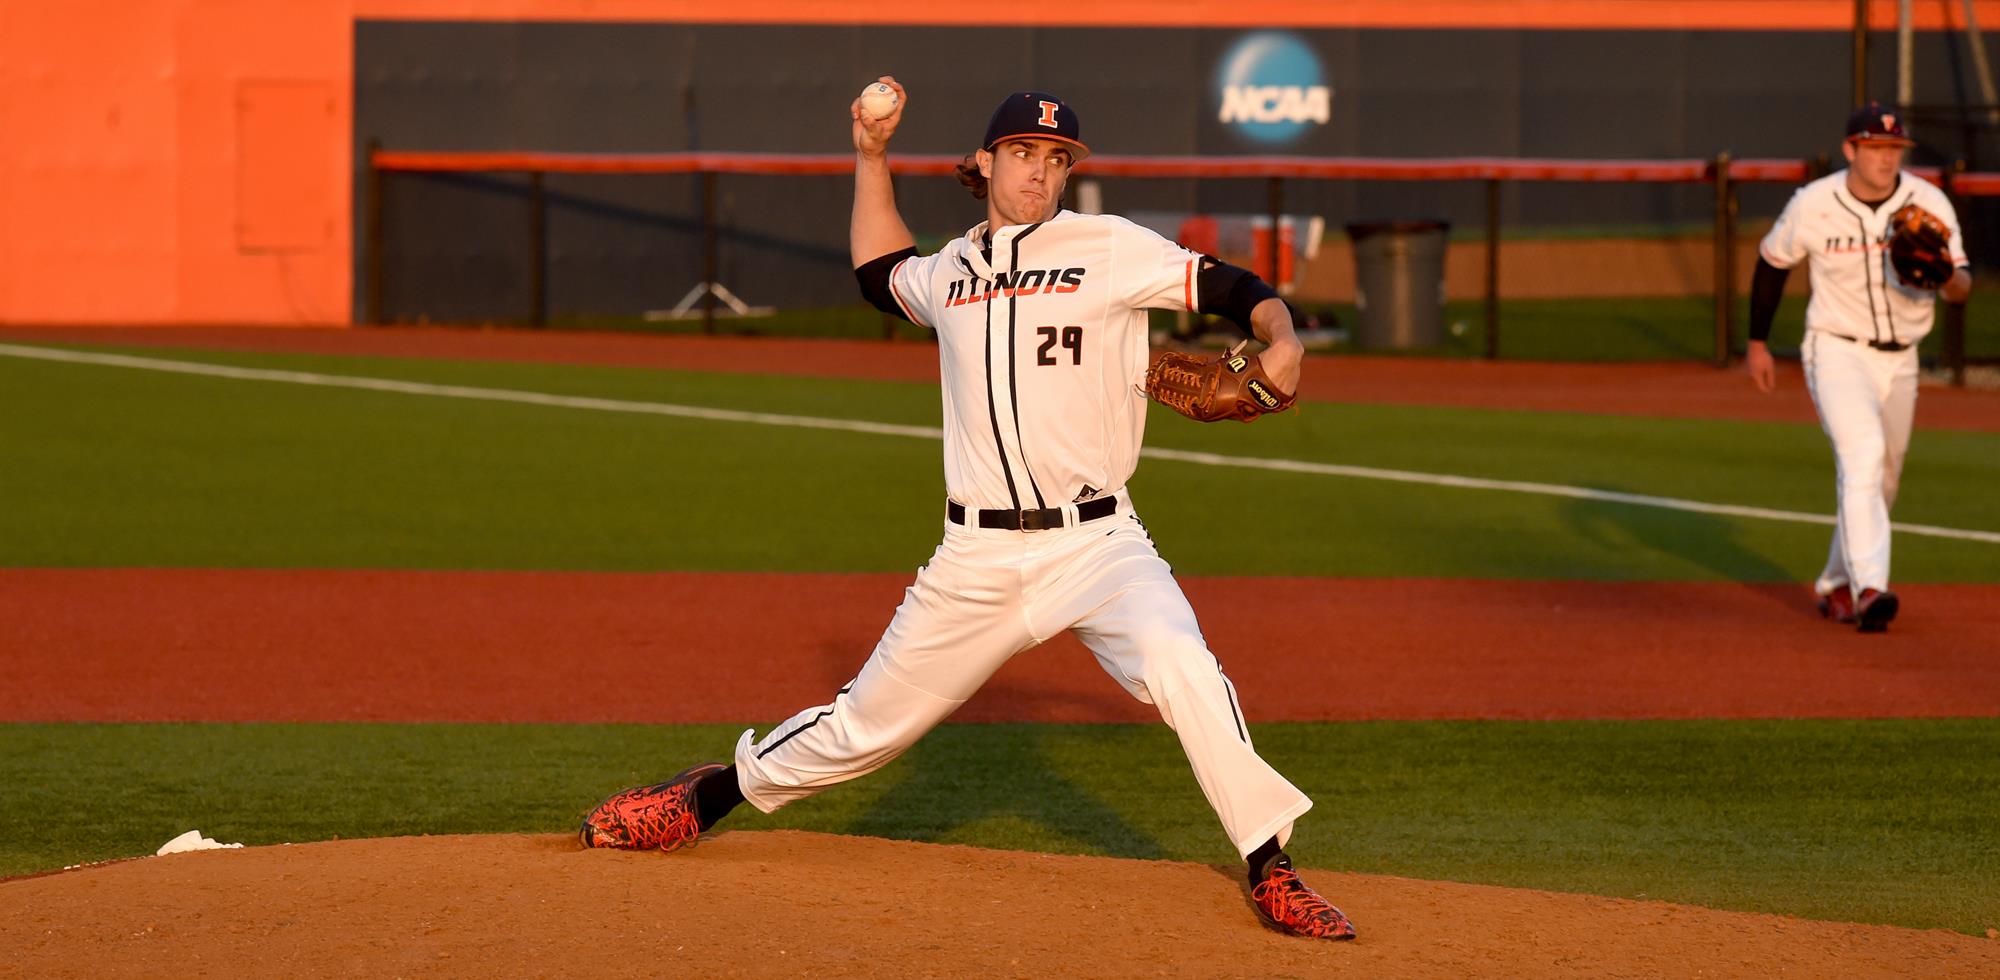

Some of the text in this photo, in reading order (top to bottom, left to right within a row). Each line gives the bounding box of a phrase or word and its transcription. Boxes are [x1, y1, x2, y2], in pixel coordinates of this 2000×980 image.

[1038, 100, 1058, 128] I
[1219, 86, 1329, 123] NCAA
[945, 268, 1085, 308] ILLINOIS
[1036, 326, 1083, 366] 29
[1248, 381, 1278, 407] Wilson
